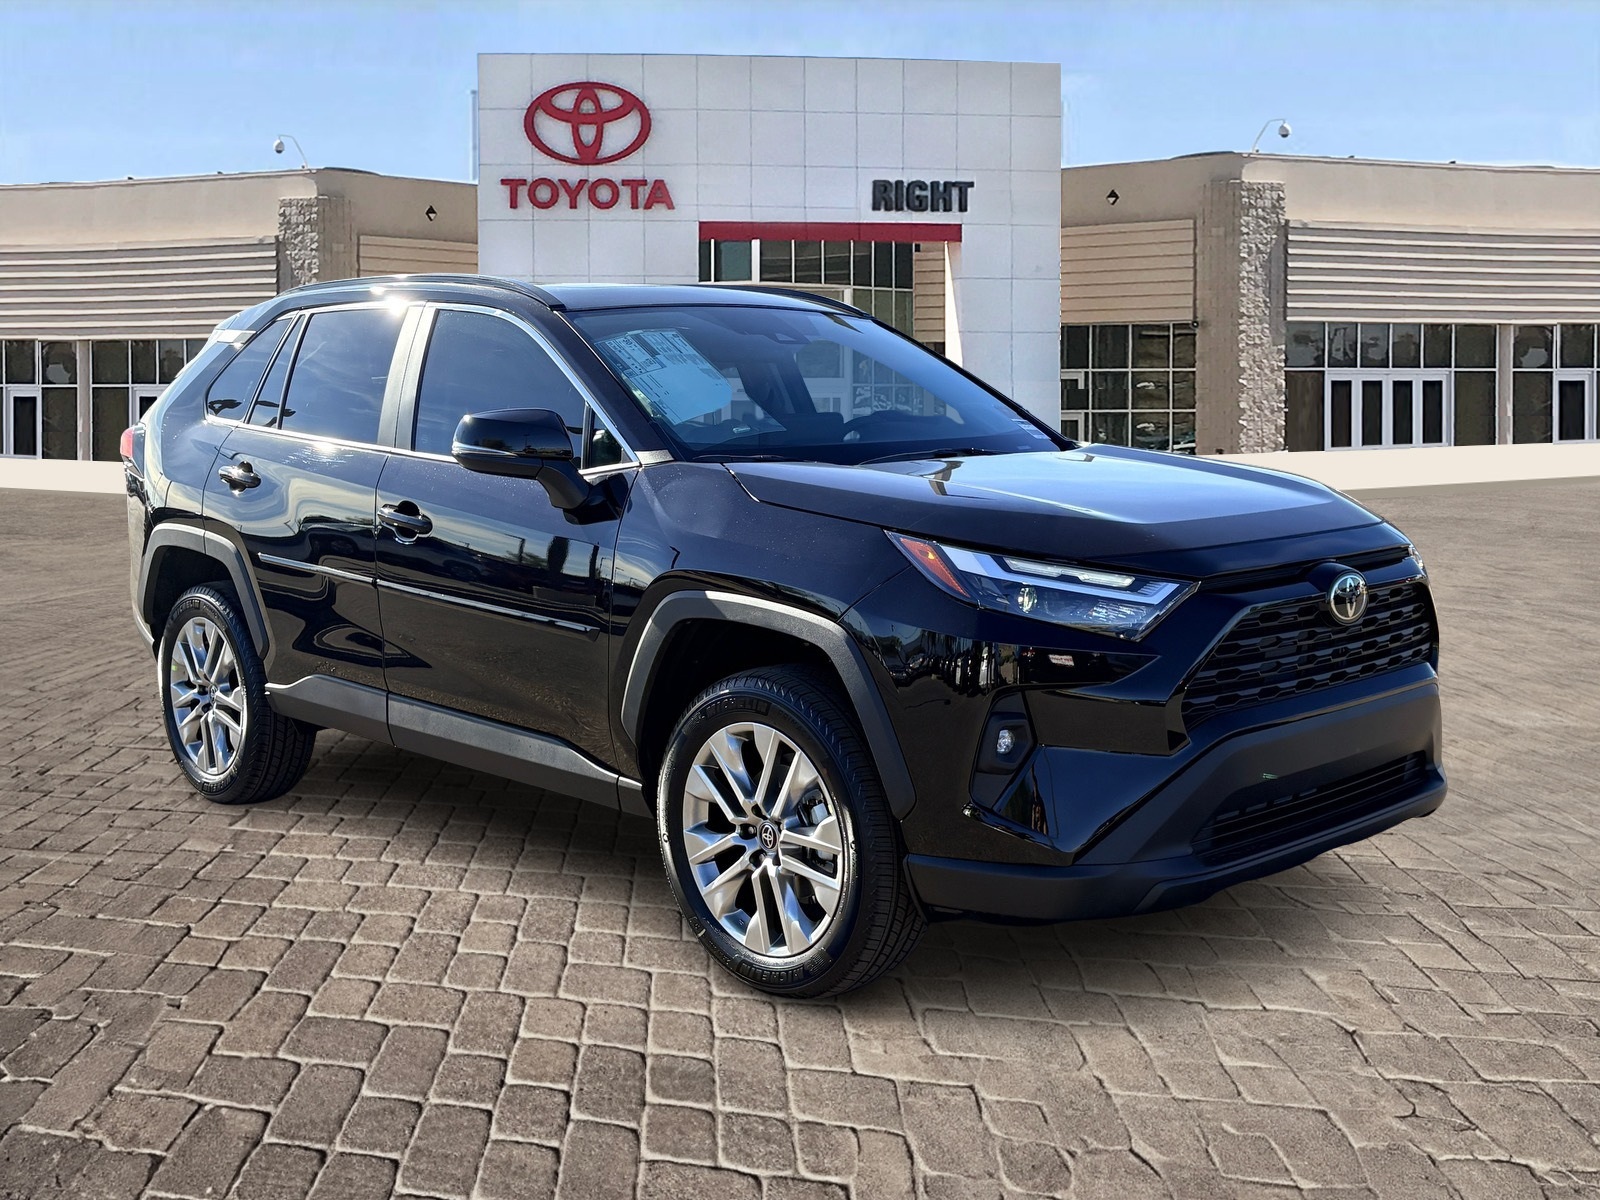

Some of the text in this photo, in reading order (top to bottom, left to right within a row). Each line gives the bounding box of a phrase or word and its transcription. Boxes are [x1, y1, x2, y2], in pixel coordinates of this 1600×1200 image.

[500, 177, 676, 210] TOYOTA
[871, 179, 975, 212] RIGHT
[738, 962, 805, 984] MICHELIN
